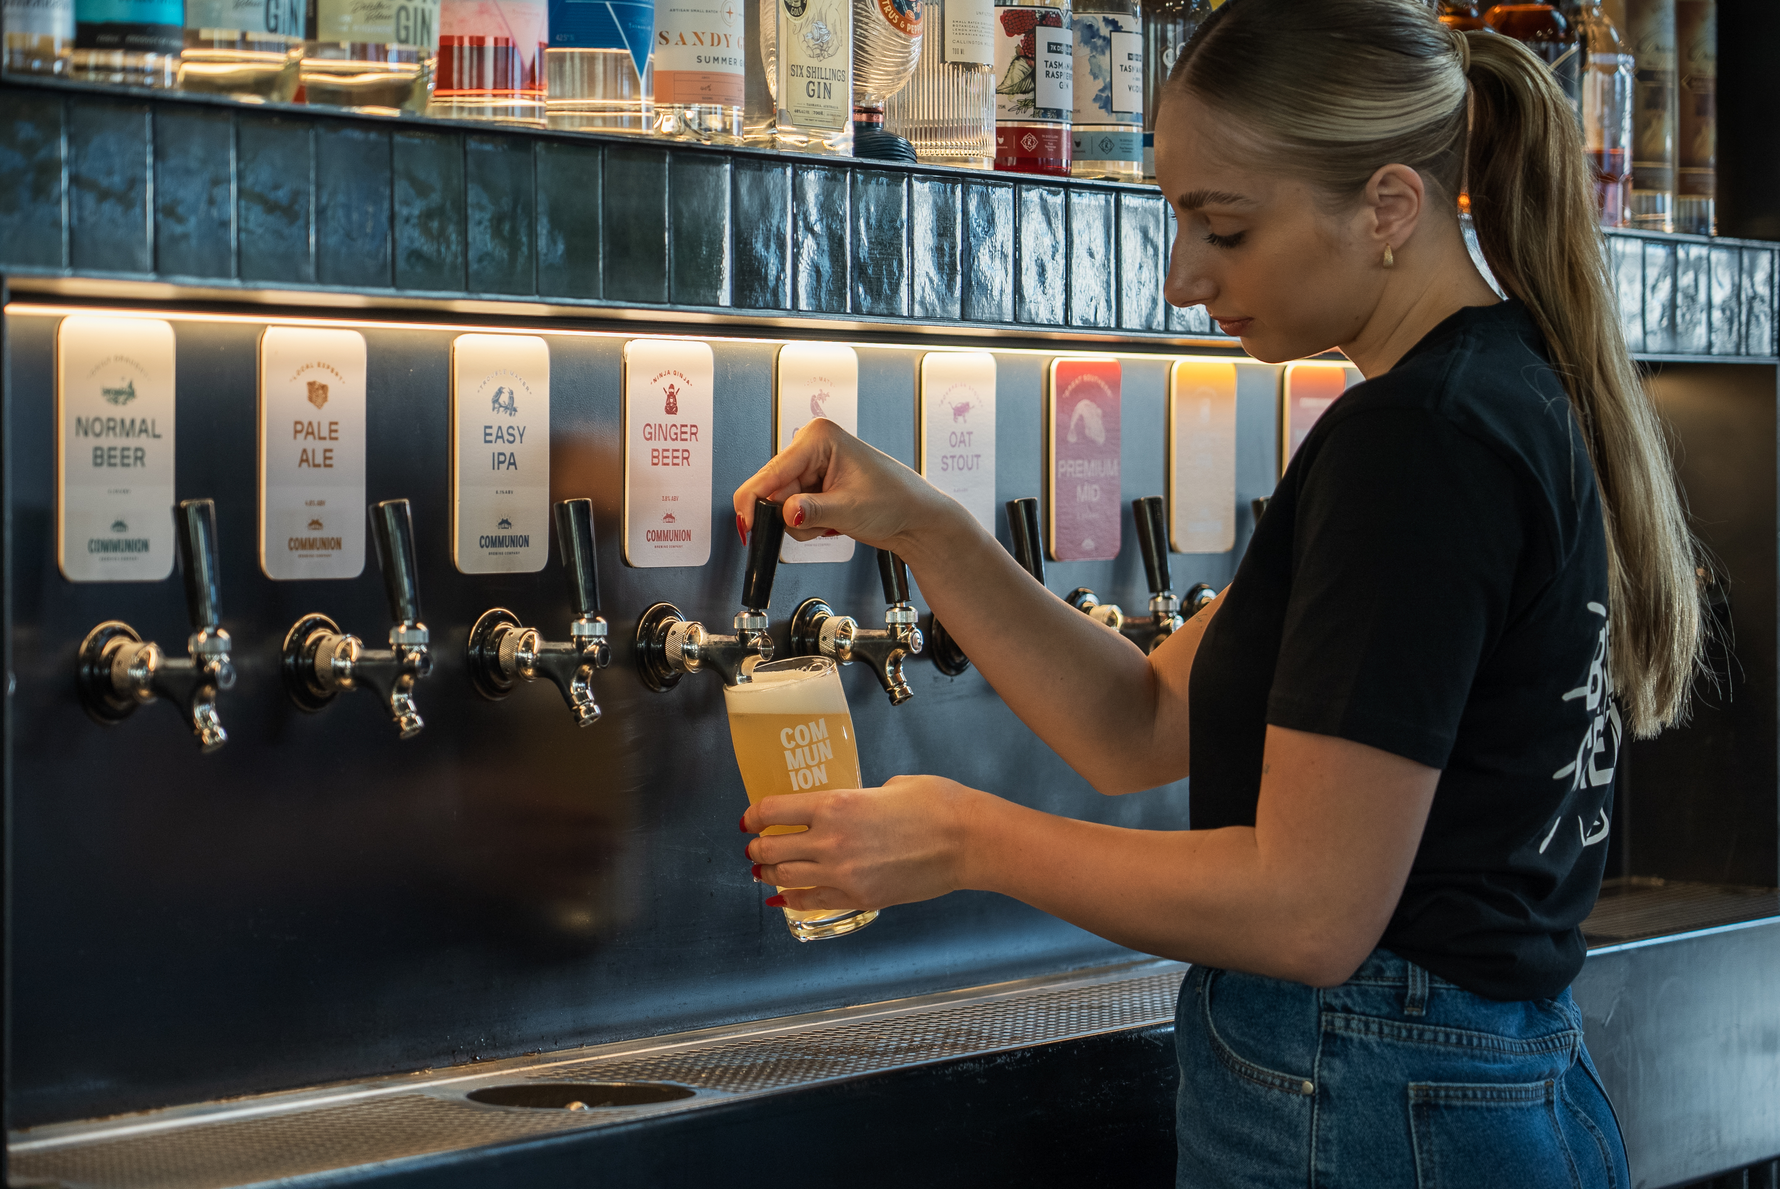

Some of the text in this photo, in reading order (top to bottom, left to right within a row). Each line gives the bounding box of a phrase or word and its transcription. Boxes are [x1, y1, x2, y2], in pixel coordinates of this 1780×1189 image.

[395, 5, 433, 47] GIN
[658, 30, 732, 48] SANDY
[696, 55, 738, 66] SUMMER
[790, 64, 846, 82] SIX SHILLINGS
[806, 80, 832, 100] GIN
[479, 369, 530, 392] TROUBLE MAKER
[653, 370, 690, 385] NINJA GINJA
[75, 416, 162, 439] NORMAL
[294, 421, 339, 440] PALE
[483, 425, 526, 444] EASY
[643, 423, 699, 442] GINGER
[949, 431, 973, 448] OAT
[92, 446, 146, 468] BEER
[298, 448, 334, 468] ALE
[492, 452, 518, 470] IPA
[651, 448, 690, 467] BEER
[940, 454, 982, 472] STOUT
[1058, 459, 1118, 478] PREMIUM
[1076, 484, 1100, 502] MID
[88, 537, 150, 554] COMMUNION
[288, 537, 342, 551] COMMUNION
[479, 535, 530, 548] COMMUNION
[646, 530, 692, 542] COMMUNION
[780, 718, 829, 749] COM
[784, 739, 834, 770] MUN
[788, 764, 828, 791] ION
